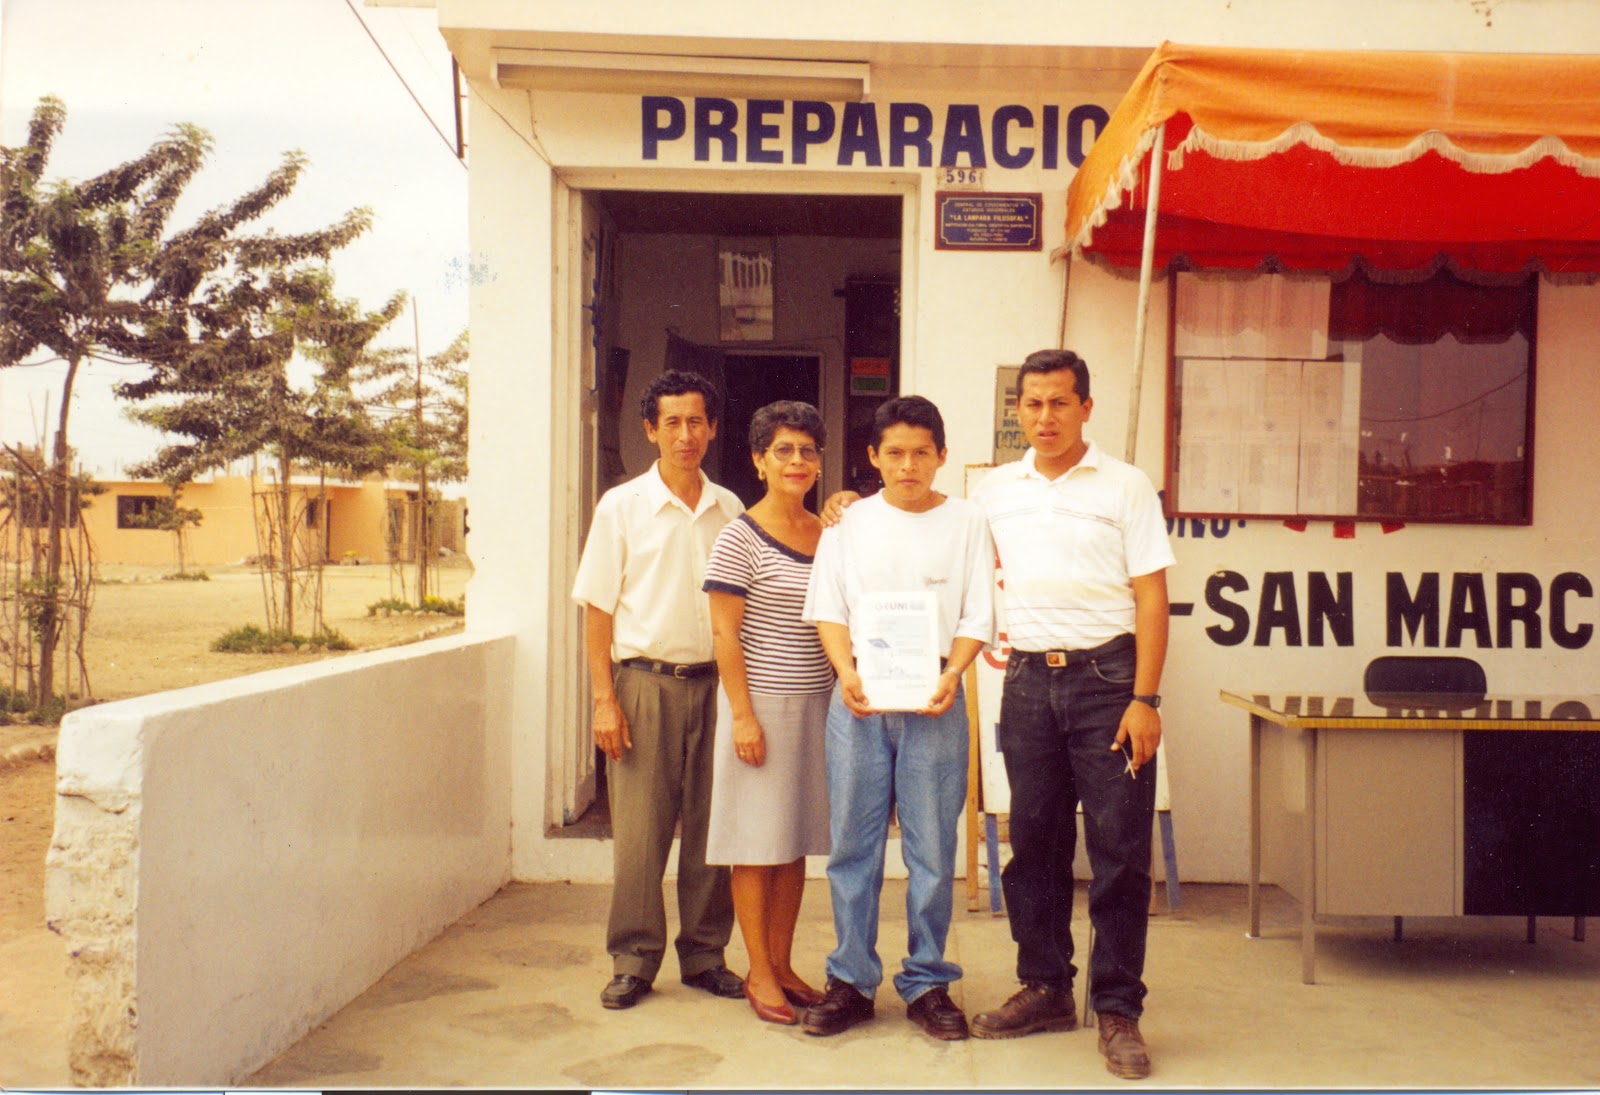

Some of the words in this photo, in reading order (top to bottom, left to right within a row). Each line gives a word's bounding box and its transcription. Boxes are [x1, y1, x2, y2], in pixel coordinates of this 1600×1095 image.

[641, 96, 1110, 169] PREPARACIO
[946, 170, 976, 183] 596
[1386, 571, 1594, 649] MARC
